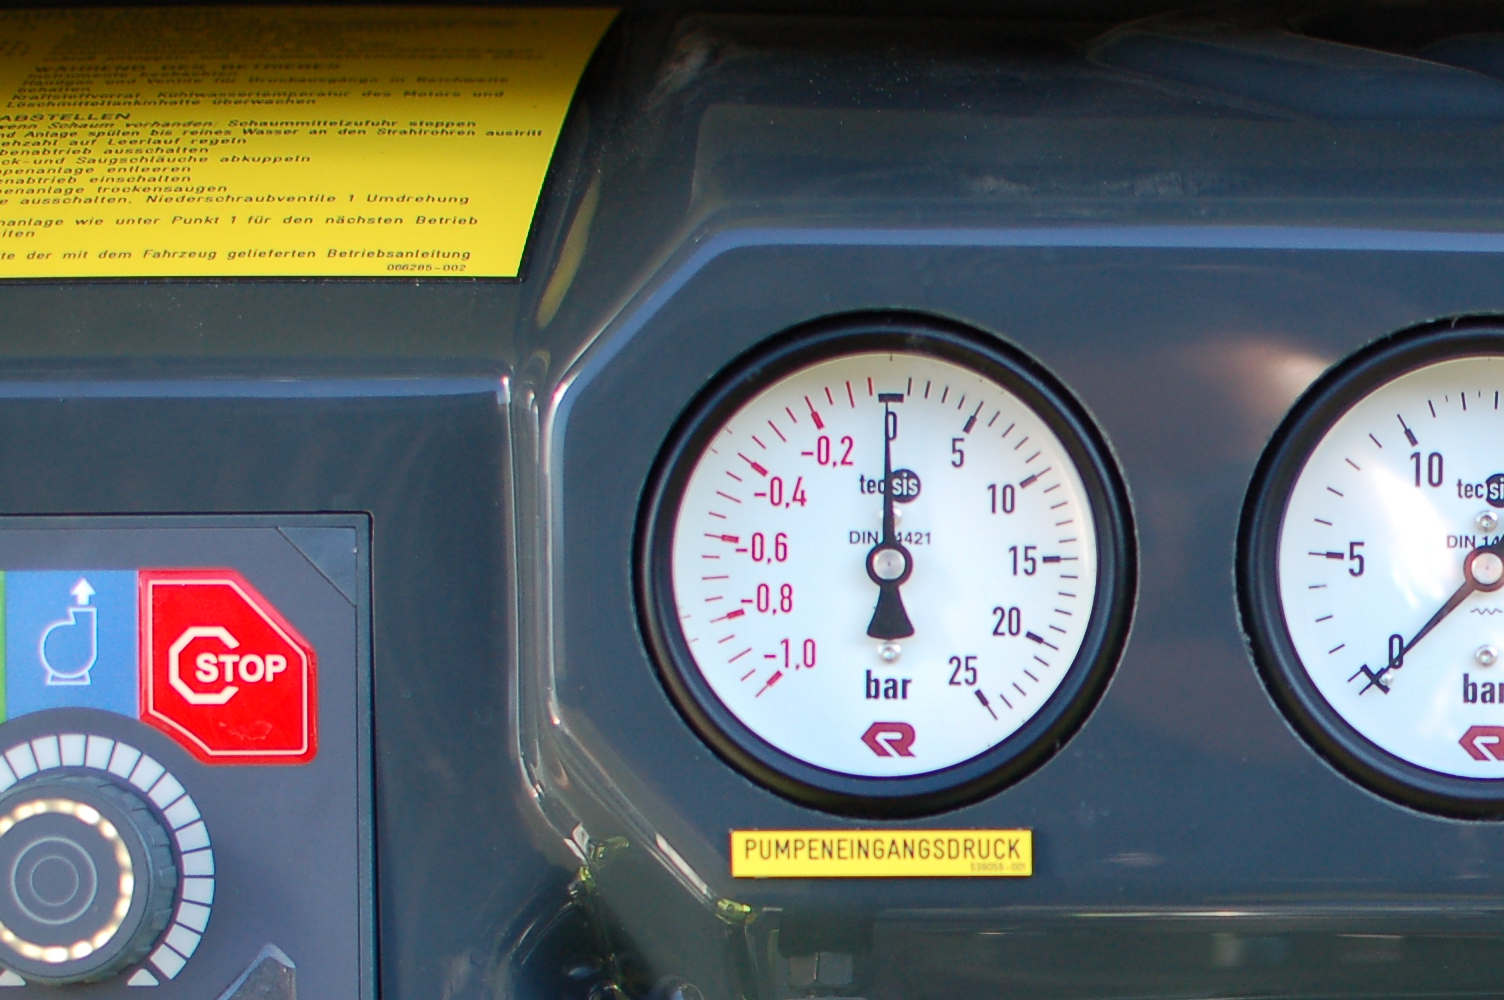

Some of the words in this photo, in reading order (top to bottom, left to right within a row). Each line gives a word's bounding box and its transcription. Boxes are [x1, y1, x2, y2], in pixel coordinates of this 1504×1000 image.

[0, 166, 94, 175] penanlage
[106, 165, 191, 173] entleeren
[76, 156, 209, 165] Saugschläuche
[219, 154, 311, 164] abkuppeln
[0, 186, 85, 195] enanlage
[97, 185, 228, 194] trockensaugen
[89, 175, 191, 183] einschalten
[145, 194, 336, 204] Niederschraubventile
[348, 194, 355, 203] 1
[366, 194, 470, 205] Umdrehung
[75, 216, 104, 225] wie
[115, 216, 160, 226] unter
[171, 215, 220, 225] Punkt
[230, 215, 237, 225] 1
[247, 214, 272, 225] für
[282, 215, 314, 225] den
[325, 214, 404, 225] nächsten
[416, 215, 478, 225] Betrieb
[26, 251, 53, 260] der
[62, 250, 89, 260] mit
[98, 250, 132, 260] dem
[143, 250, 217, 262] Fahrzeug
[227, 250, 316, 262] gelieferten
[327, 249, 471, 261] Betriebsanleitung
[801, 435, 854, 469] -0,2
[951, 438, 965, 468] 5
[1409, 451, 1443, 488] 10
[754, 475, 807, 509] -0,4
[986, 483, 1015, 514] 10
[735, 531, 788, 565] -0,6
[848, 530, 879, 545] DIN
[1446, 535, 1476, 549] DIN
[1008, 545, 1037, 577] 15
[1349, 541, 1365, 577] 5
[740, 583, 793, 614] -0,8
[991, 606, 1021, 636] 20
[763, 637, 816, 671] -1,0
[1388, 633, 1404, 670] 0
[195, 652, 287, 683] STOP
[948, 655, 978, 686] 25
[865, 669, 912, 700] bar
[745, 838, 1021, 860] PUMPENEINGANGSDRUCK
